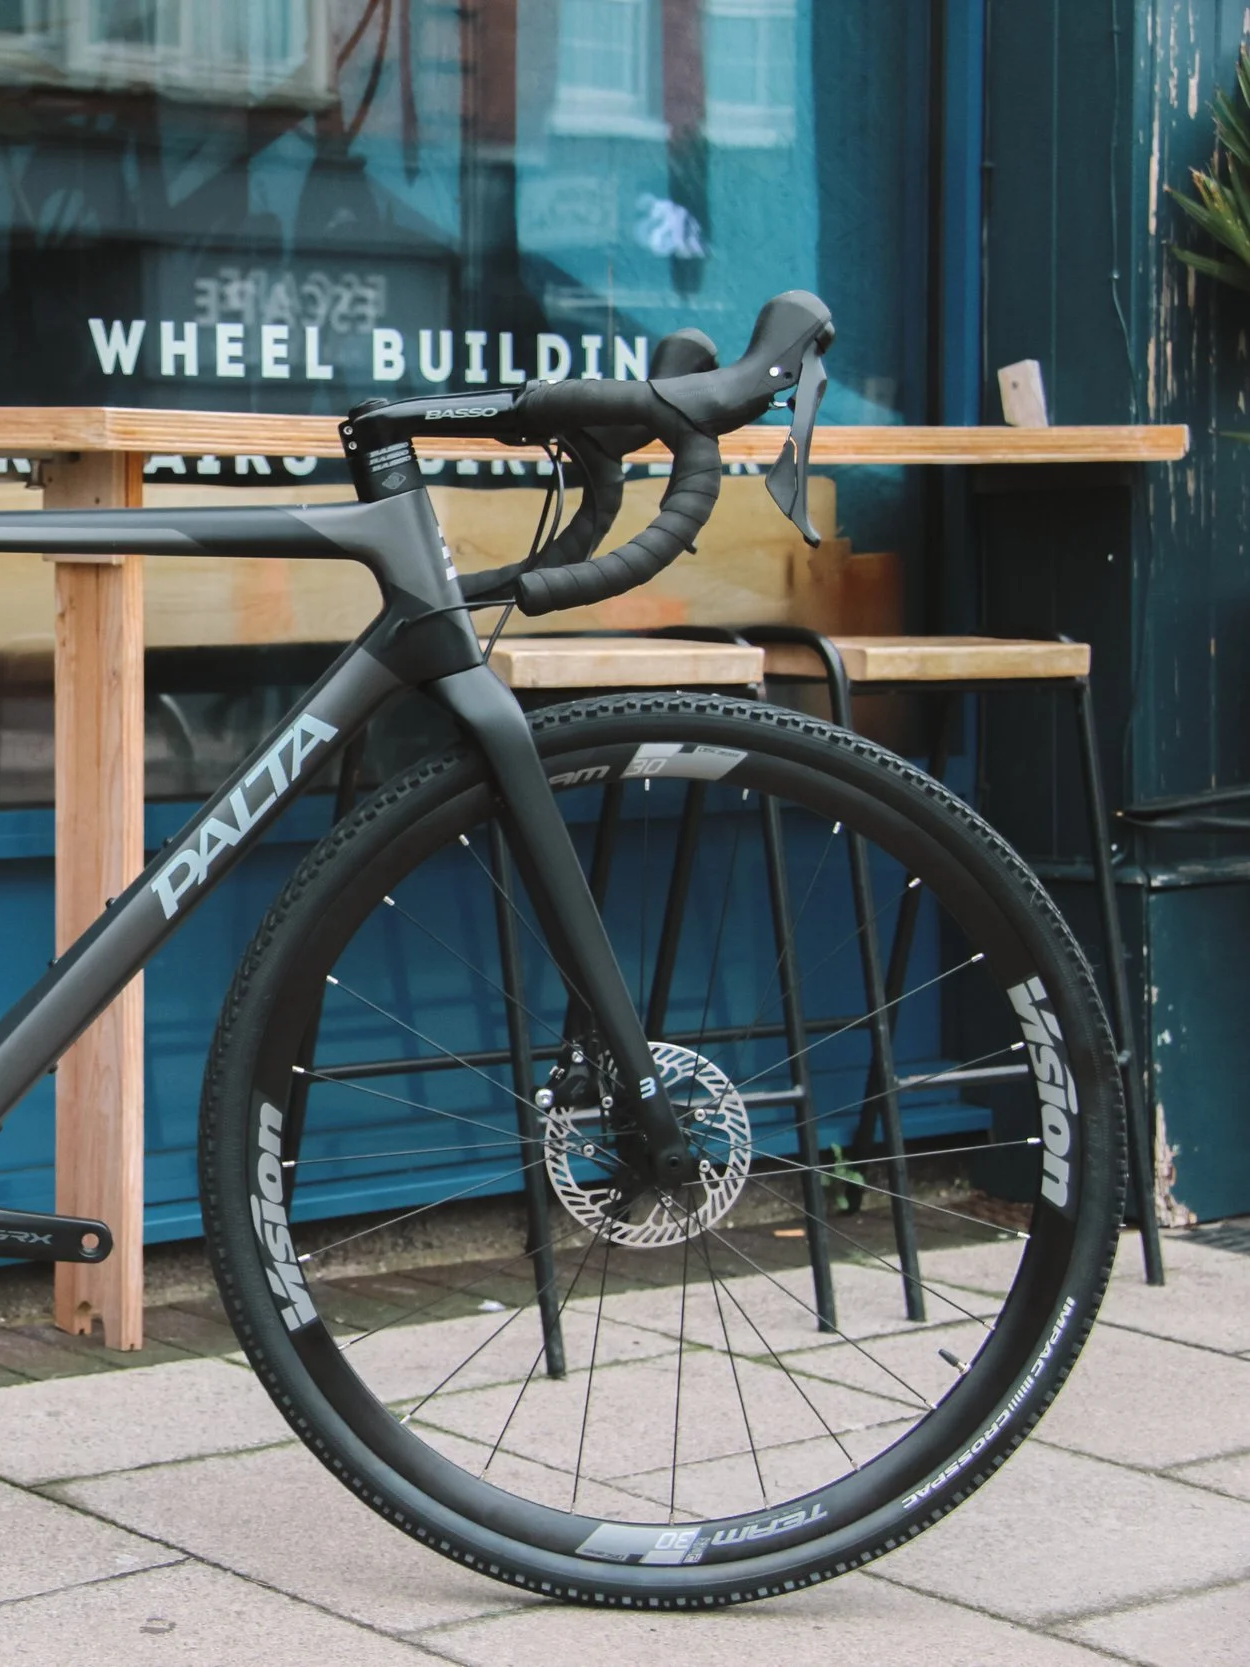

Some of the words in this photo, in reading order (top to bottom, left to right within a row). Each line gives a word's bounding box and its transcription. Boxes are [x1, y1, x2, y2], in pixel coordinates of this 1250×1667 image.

[88, 318, 333, 380] WHEEL
[373, 328, 649, 384] BUILDIN
[425, 407, 498, 420] BASSO
[548, 765, 610, 785] AM
[623, 758, 667, 776] 30
[151, 713, 339, 920] PALTA
[1031, 1296, 1077, 1378] IMPAC
[902, 1407, 1011, 1509] CROSSPAC
